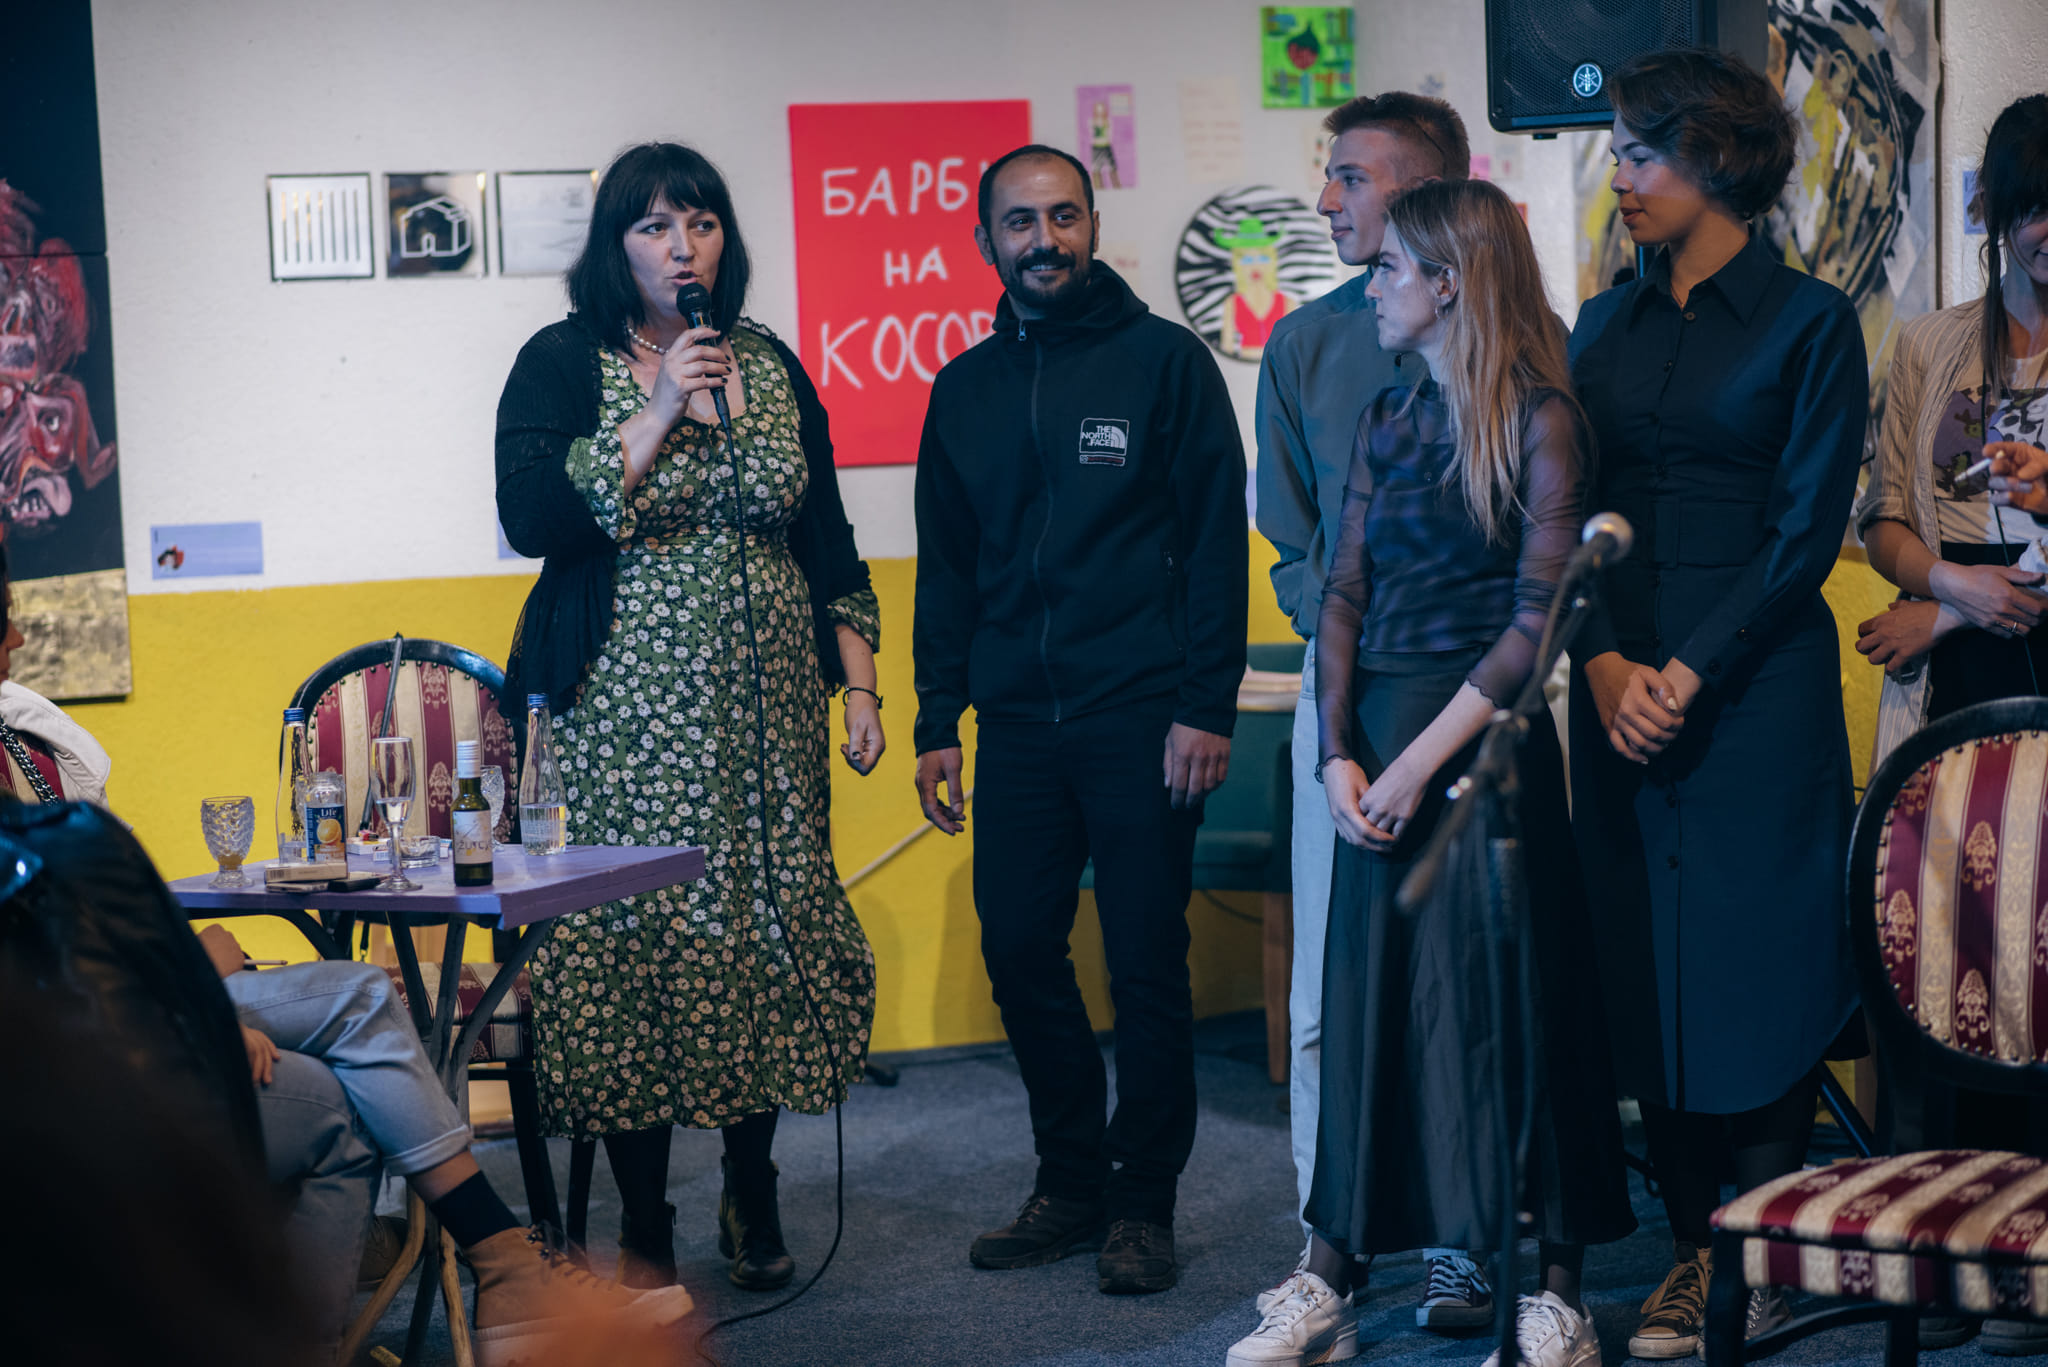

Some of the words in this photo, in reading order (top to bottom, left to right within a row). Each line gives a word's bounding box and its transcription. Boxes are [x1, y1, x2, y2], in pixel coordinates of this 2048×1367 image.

[822, 158, 989, 216] БАРБ
[883, 246, 949, 287] НА
[1096, 425, 1112, 433] THE
[1081, 432, 1111, 441] NORTH
[1089, 439, 1111, 447] FACE
